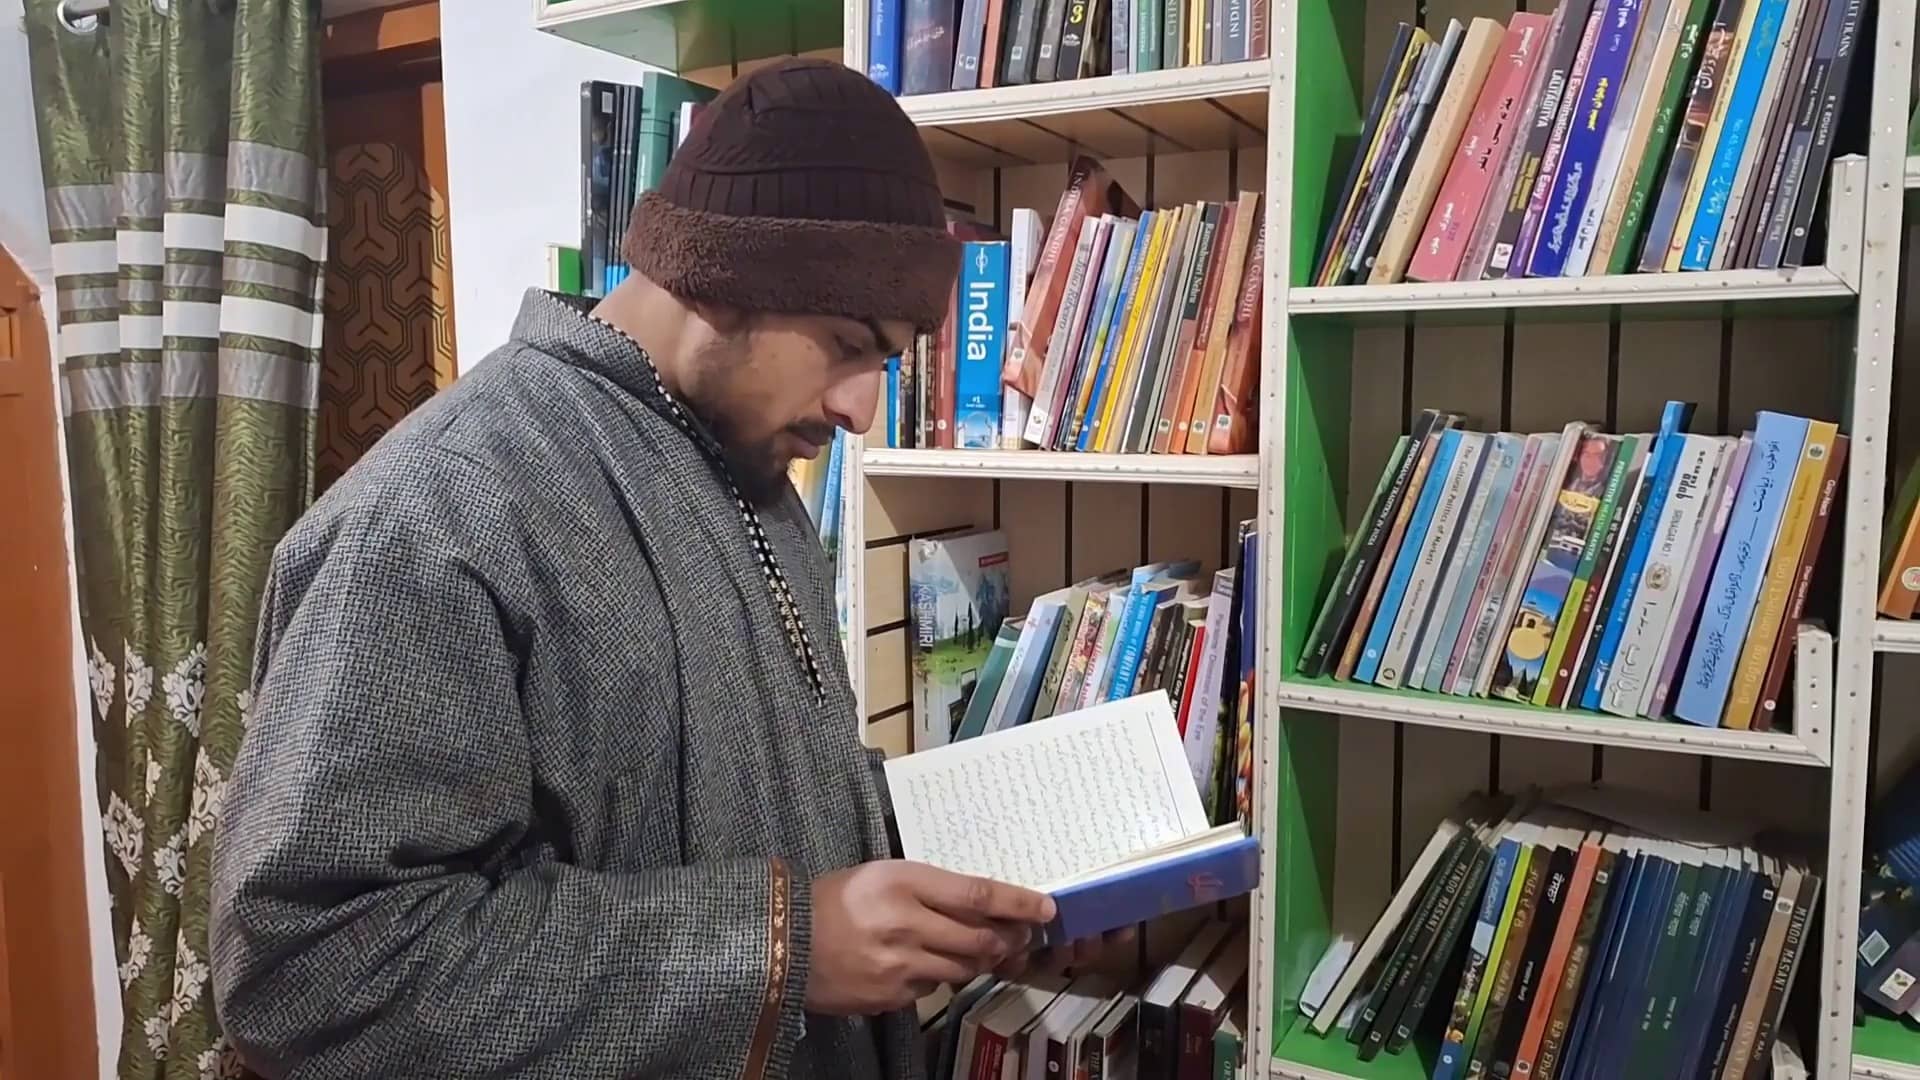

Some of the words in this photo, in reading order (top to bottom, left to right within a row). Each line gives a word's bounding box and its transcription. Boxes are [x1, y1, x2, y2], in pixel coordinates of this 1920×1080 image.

[1571, 7, 1602, 76] Neurological
[1835, 19, 1857, 57] TRAINS
[1535, 66, 1564, 129] LALITADITYA
[1552, 76, 1580, 142] Examination
[1542, 143, 1560, 173] Made
[1062, 170, 1085, 213] INDIRA
[1533, 173, 1550, 199] Easy
[1045, 214, 1070, 264] GANDHI
[1193, 222, 1216, 275] Rameshwari
[1070, 256, 1087, 287] Julio
[1186, 274, 1203, 305] Nehru
[1058, 286, 1079, 330] Ribeiro
[1241, 263, 1260, 318] GANDHI
[967, 282, 995, 361] India
[1395, 438, 1421, 485] PERFORMANCE
[1463, 443, 1475, 459] The
[1450, 459, 1469, 492] Cultural
[1603, 459, 1626, 503] PREVENTIVE
[1379, 486, 1399, 519] TRADITION
[1439, 492, 1457, 524] Politics
[1366, 527, 1380, 547] INDIA
[1375, 518, 1384, 528] IN
[1436, 523, 1445, 534] of
[1424, 534, 1442, 566] Markets
[1583, 530, 1601, 561] MANTRA
[919, 584, 934, 648] KASHMIRI
[1200, 653, 1217, 694] Diseases
[1197, 707, 1207, 723] the
[1199, 696, 1209, 707] of
[1192, 723, 1204, 741] Eye
[1444, 860, 1468, 894] MINOO
[1424, 893, 1450, 932] MASANI
[1785, 905, 1808, 945] MINOO
[1771, 947, 1796, 993] MASANI
